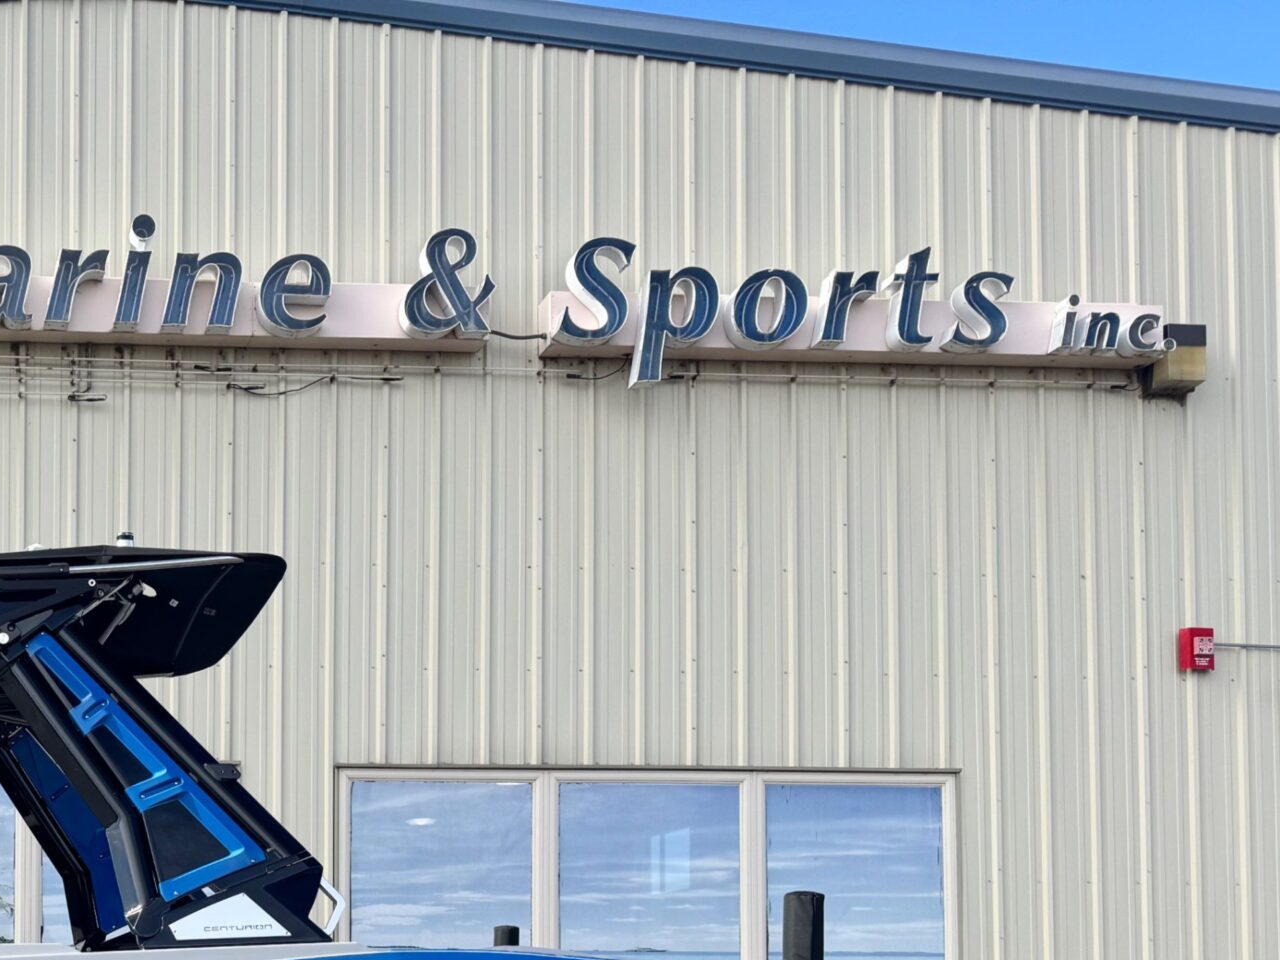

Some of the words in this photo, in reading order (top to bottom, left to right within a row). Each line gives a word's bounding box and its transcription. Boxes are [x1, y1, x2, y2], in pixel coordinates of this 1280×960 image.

[399, 227, 496, 339] &
[548, 237, 1014, 389] Sports
[1050, 294, 1177, 358] inc.
[203, 924, 273, 932] CENTURION
